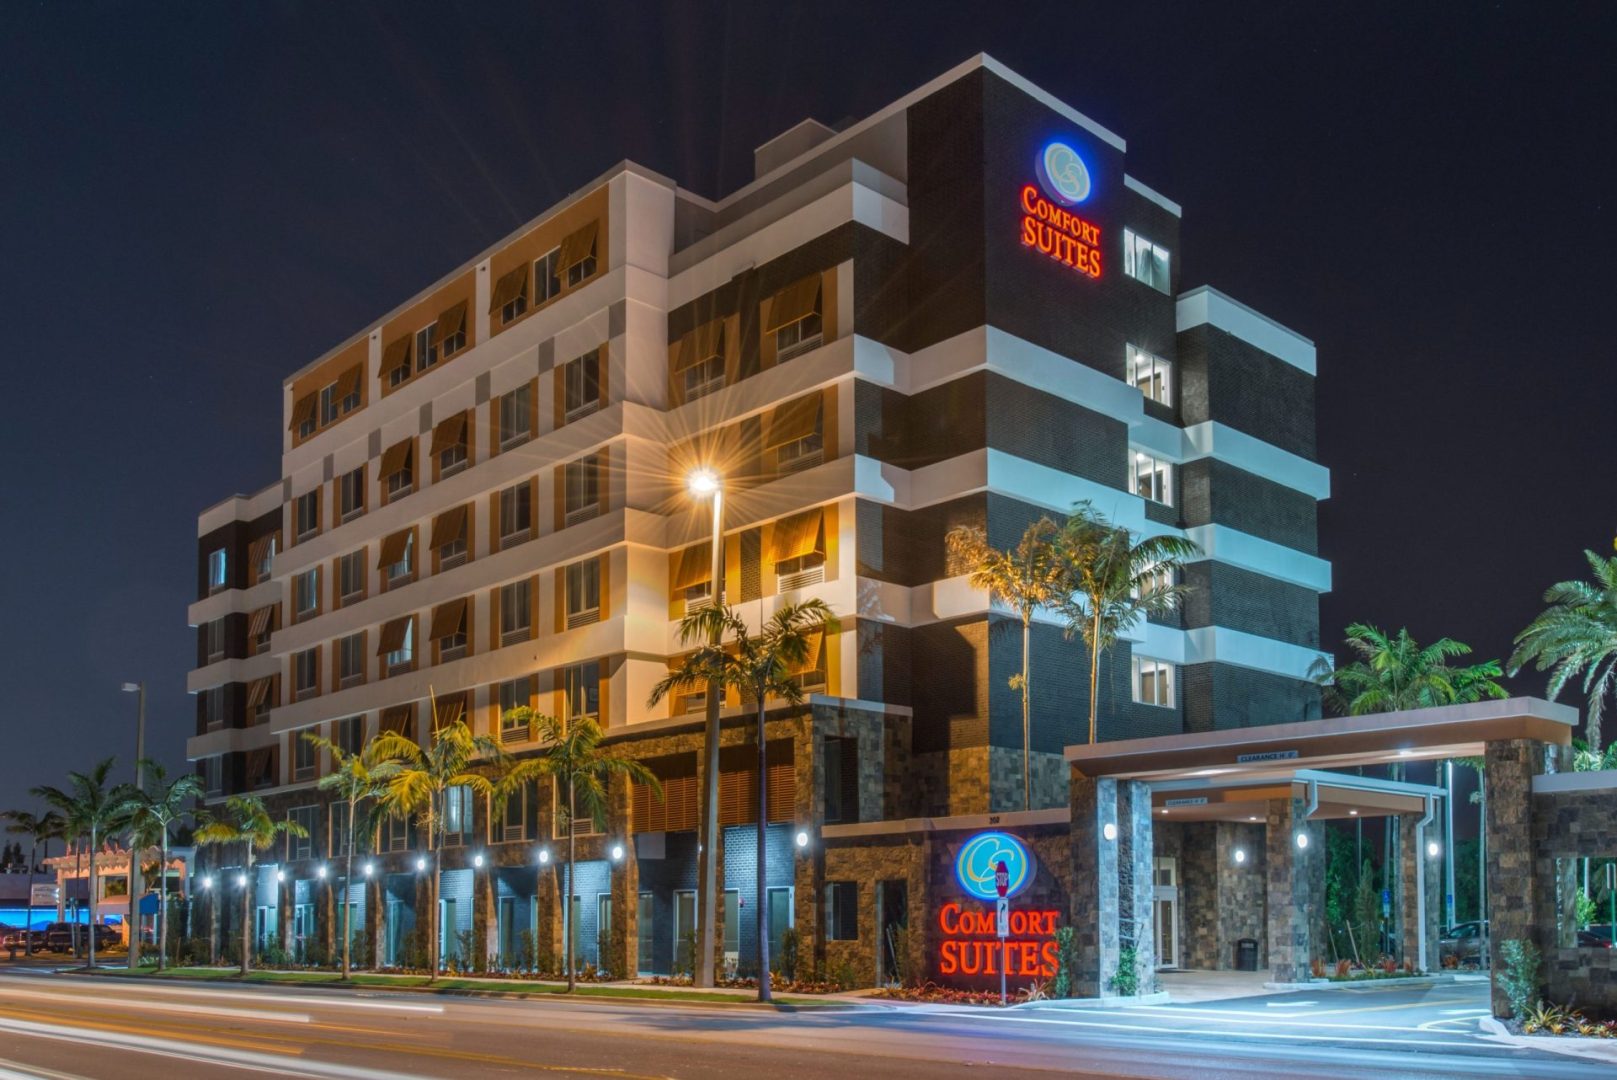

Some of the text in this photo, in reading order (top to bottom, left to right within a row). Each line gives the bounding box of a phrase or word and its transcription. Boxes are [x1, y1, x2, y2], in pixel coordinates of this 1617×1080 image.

[1023, 186, 1100, 246] COMFORT
[1023, 216, 1101, 278] SUITES
[1240, 752, 1277, 763] CLEARANCE
[995, 872, 1009, 887] STOP
[940, 903, 1060, 935] COMORT
[940, 940, 1060, 977] SUITES
